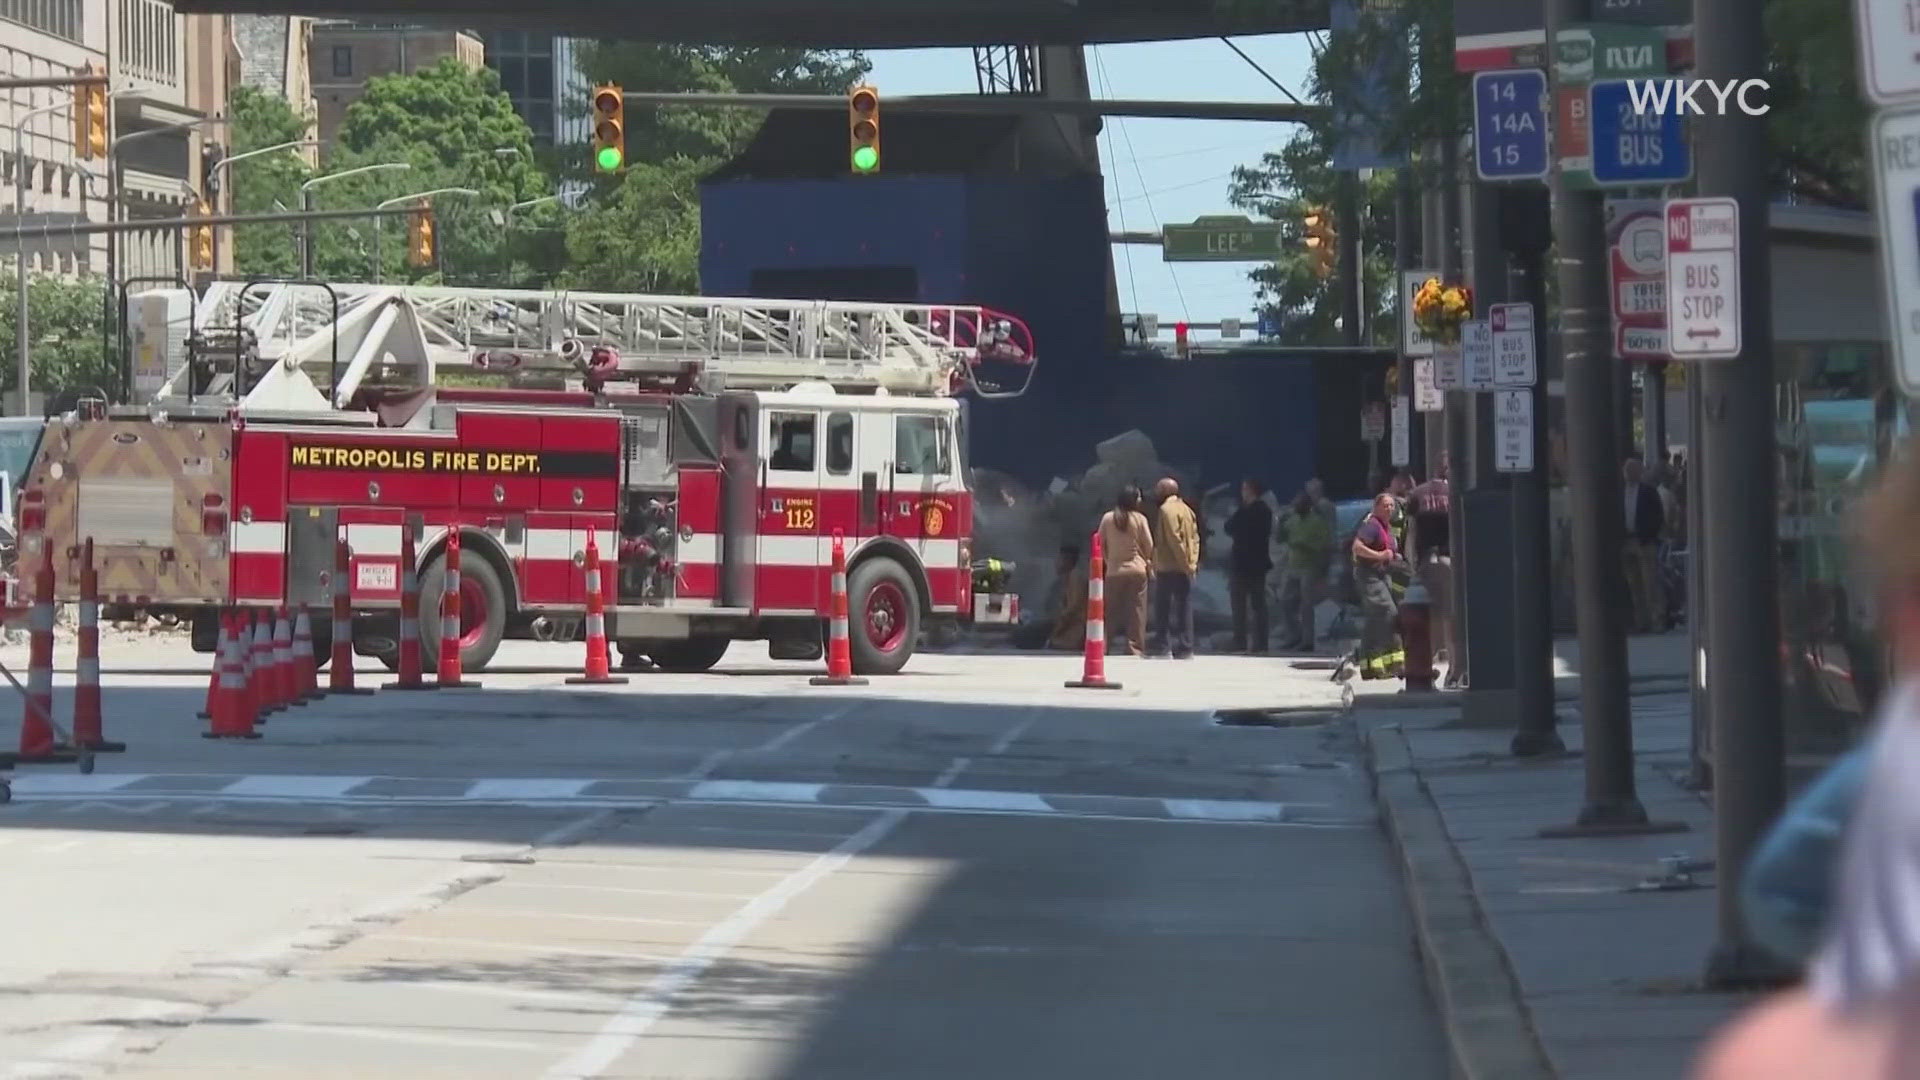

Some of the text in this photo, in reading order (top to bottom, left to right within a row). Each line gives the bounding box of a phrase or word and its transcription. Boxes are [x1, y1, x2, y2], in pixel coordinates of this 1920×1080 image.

[1489, 82, 1516, 102] 14
[1491, 112, 1535, 133] 14A
[1492, 145, 1519, 165] 15
[1618, 134, 1664, 166] BUS
[1670, 216, 1688, 241] NO
[1207, 232, 1239, 252] LEE
[1685, 264, 1720, 289] BUS
[1683, 295, 1724, 320] STOP
[1502, 338, 1523, 351] BUS
[1501, 354, 1526, 368] STOP
[1506, 398, 1520, 413] NO
[292, 447, 541, 473] METROPOLIS FIRE DEPT.
[786, 509, 814, 529] 112
